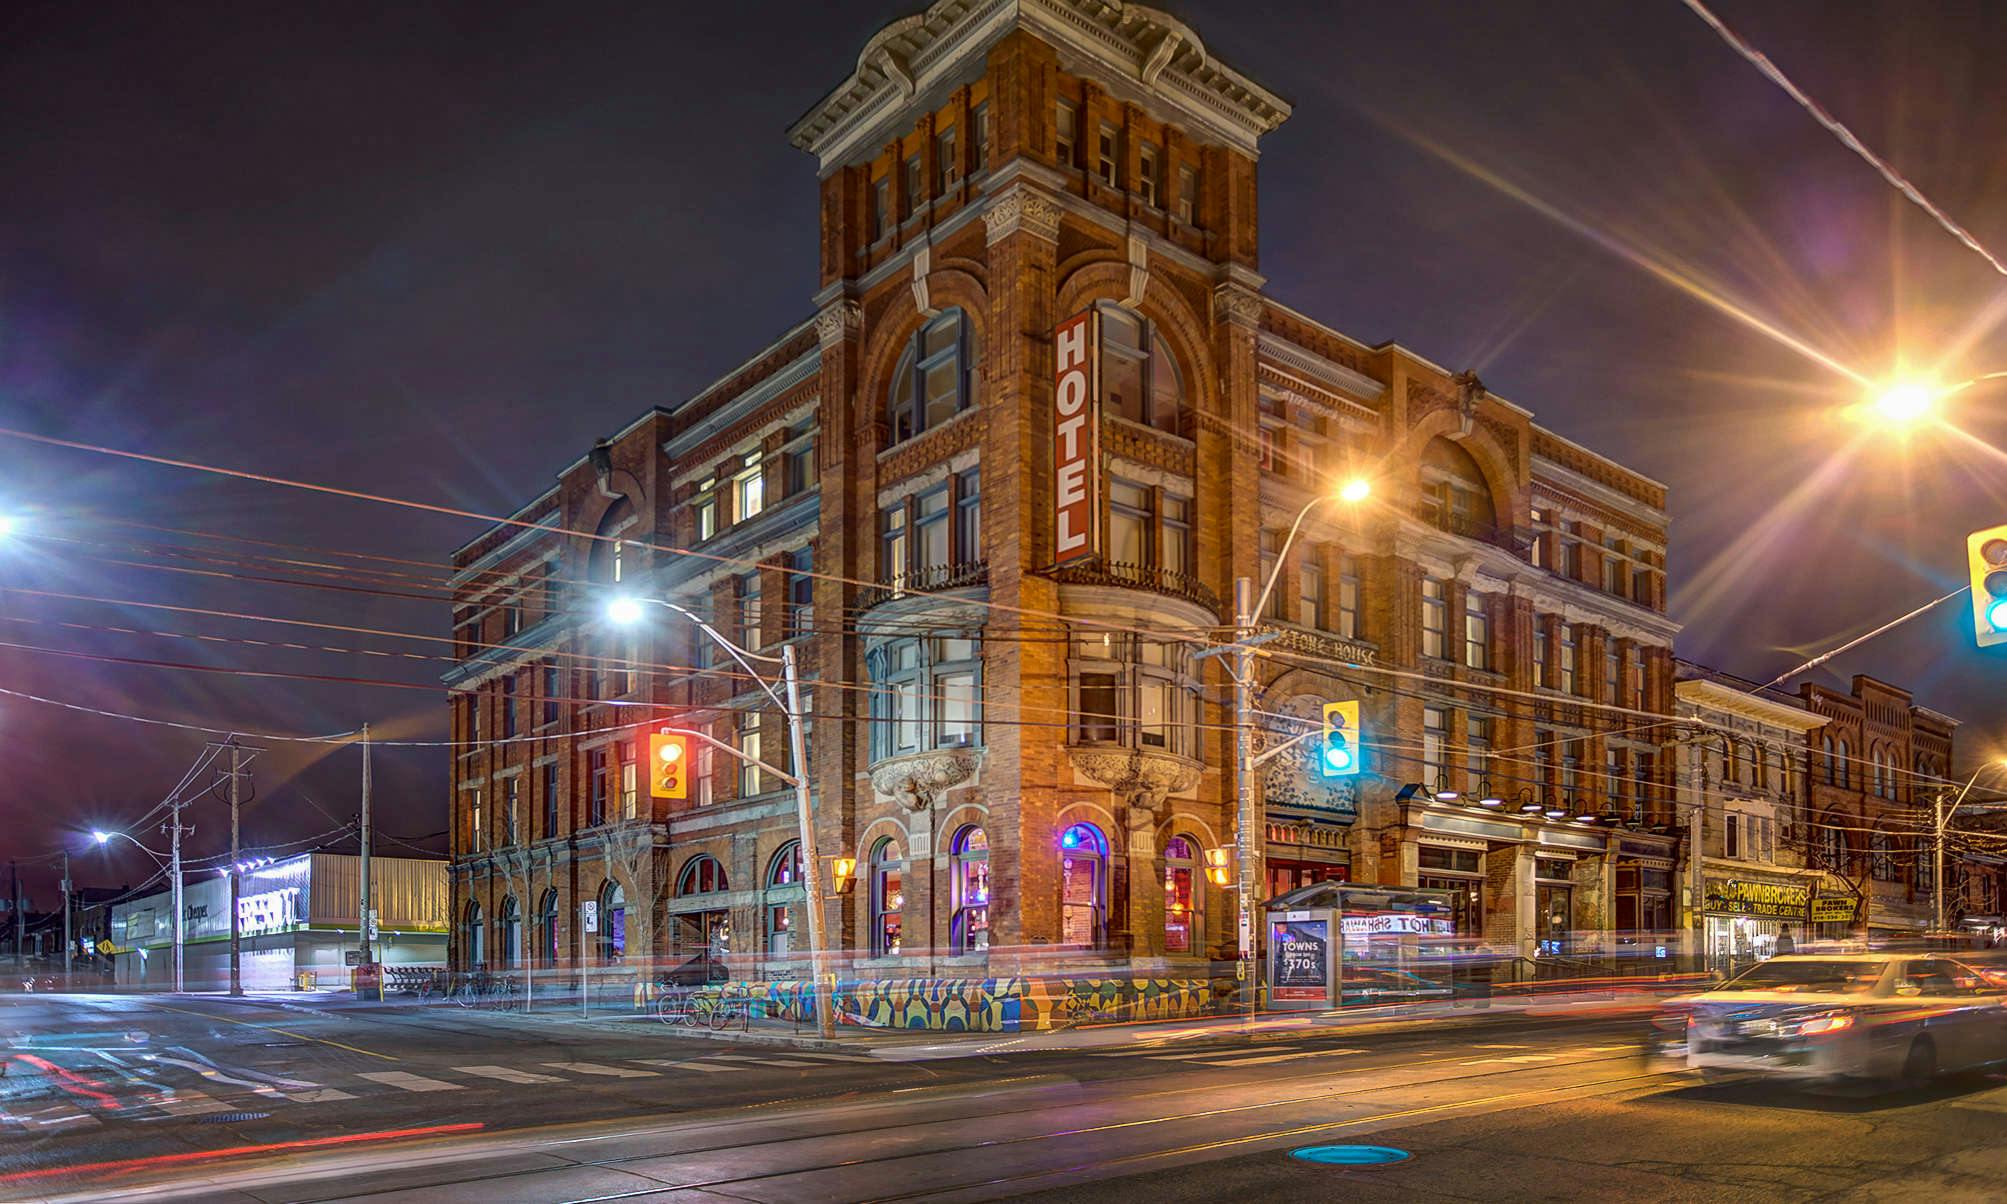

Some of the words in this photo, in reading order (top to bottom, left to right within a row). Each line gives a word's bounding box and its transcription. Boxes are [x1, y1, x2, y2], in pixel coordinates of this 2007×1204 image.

[1056, 321, 1086, 553] HOTEL
[1753, 904, 1777, 915] TRADE
[1779, 905, 1806, 917] CENTRE
[1282, 942, 1319, 952] TOWNS
